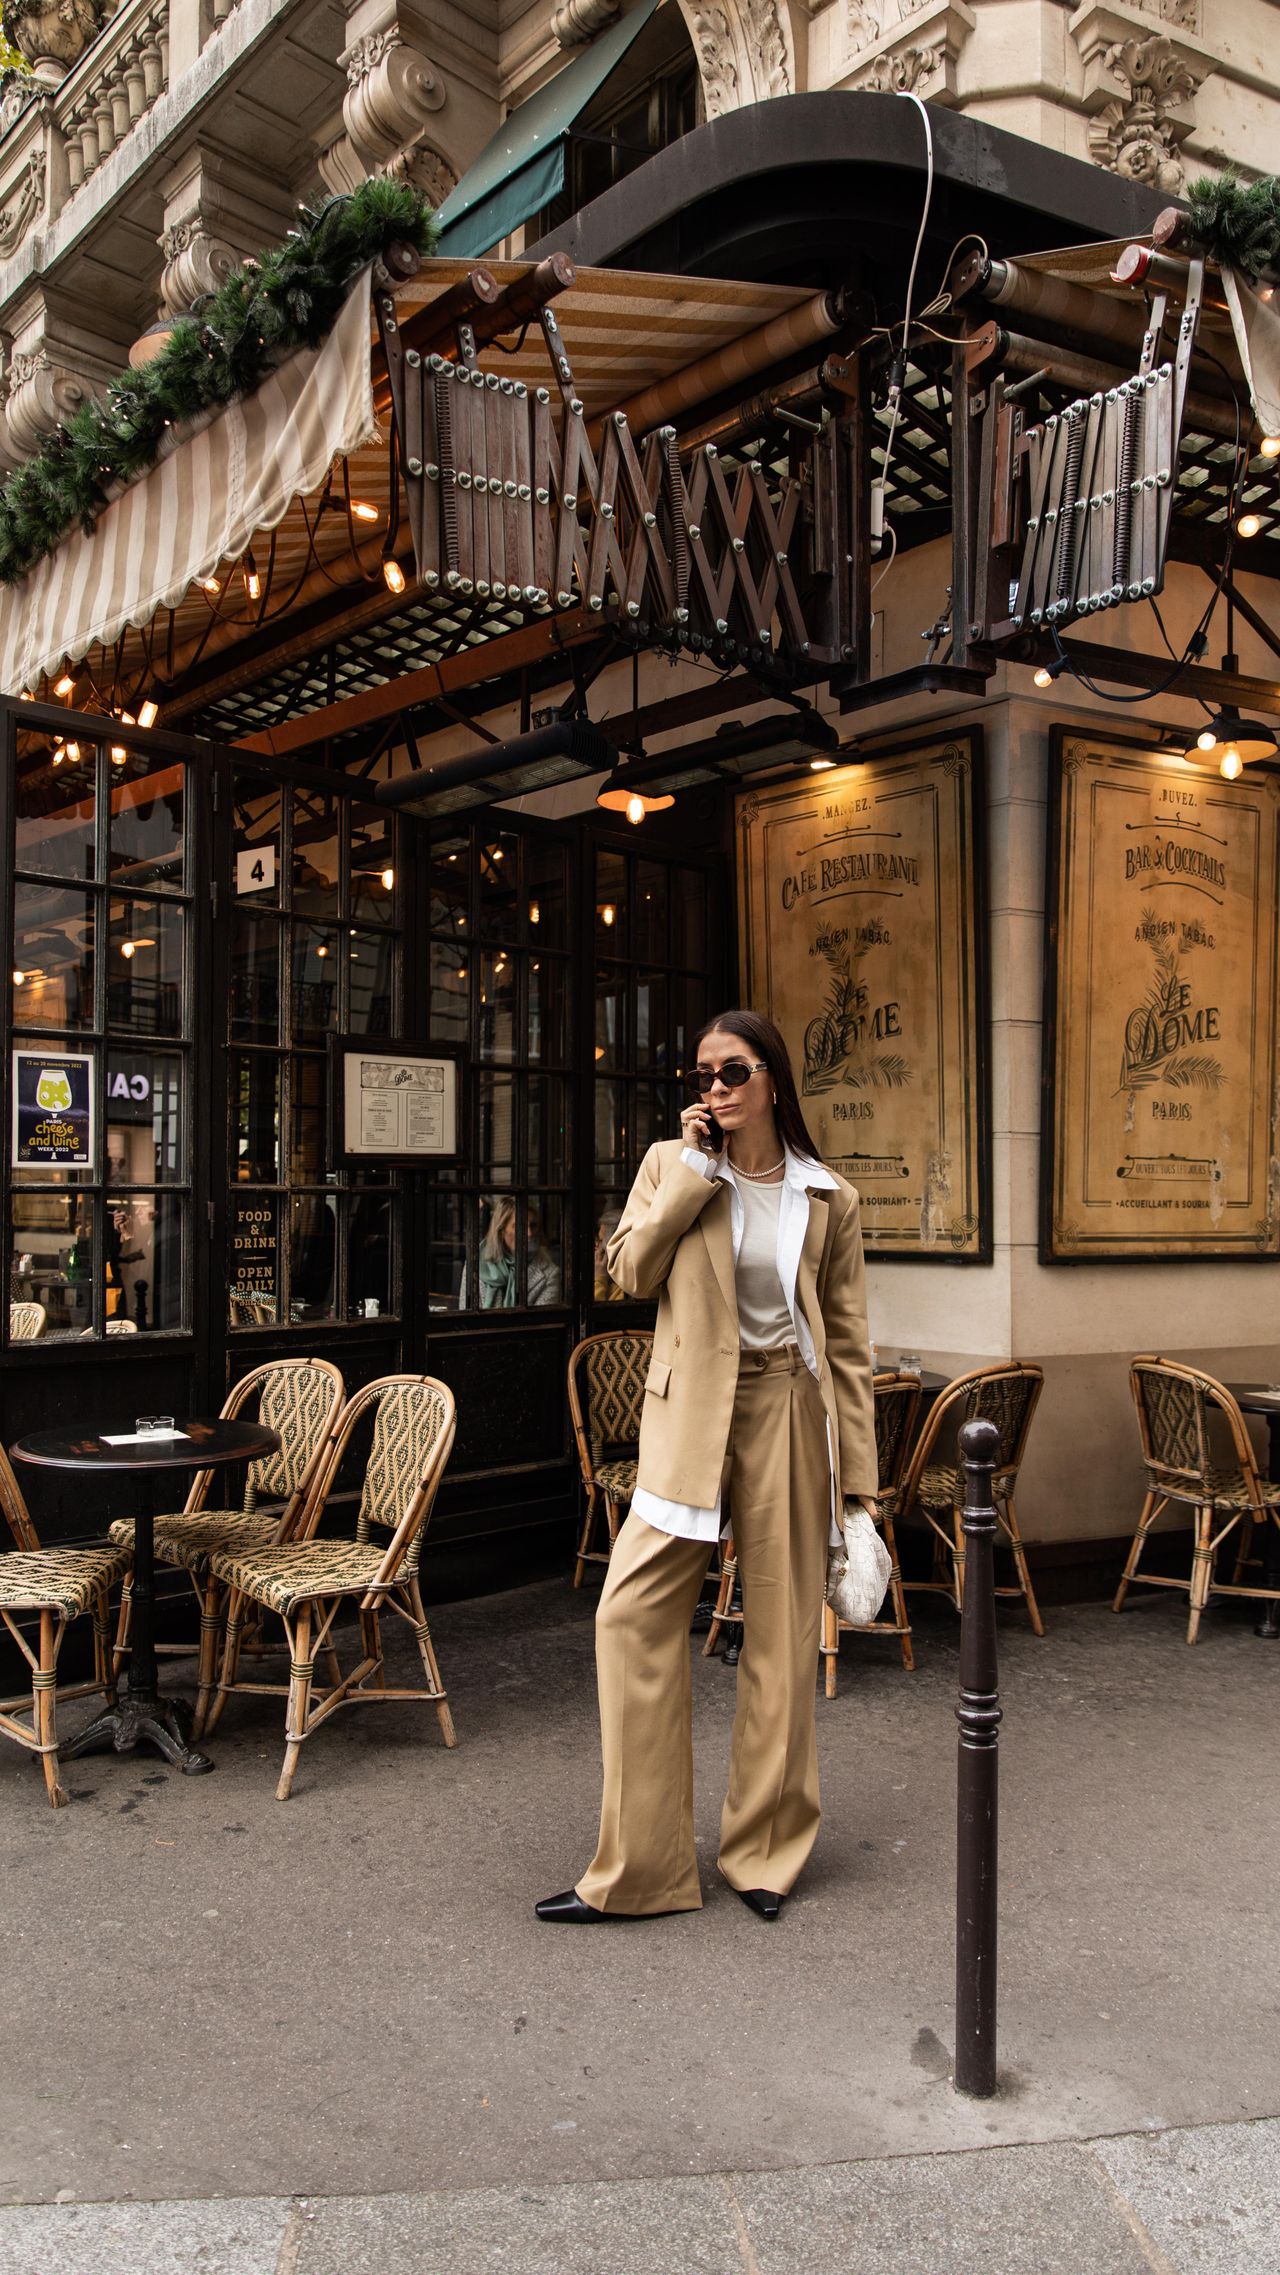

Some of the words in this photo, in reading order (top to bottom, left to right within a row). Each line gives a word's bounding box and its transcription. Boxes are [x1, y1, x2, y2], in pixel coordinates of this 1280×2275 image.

[251, 859, 264, 882] 4
[820, 853, 919, 892] RESTAURANT
[1125, 845, 1151, 880] BAR
[1165, 841, 1226, 888] COCKTAILS
[1135, 921, 1176, 942] ANCIEN
[1181, 922, 1216, 950] TABAC
[1125, 1004, 1221, 1070] DOME
[832, 1101, 874, 1120] PARIS
[1152, 1102, 1192, 1121] PARIS
[35, 1120, 74, 1137] cheese
[29, 1134, 50, 1146] and
[53, 1133, 80, 1149] wine
[867, 1197, 907, 1206] SOURIANT
[1120, 1200, 1172, 1208] ACCUEILLANT
[238, 1211, 272, 1222] FOOD
[250, 1224, 259, 1235] &
[234, 1237, 276, 1249] DRINK
[237, 1266, 272, 1278] OPEN
[236, 1279, 275, 1292] DAILY
